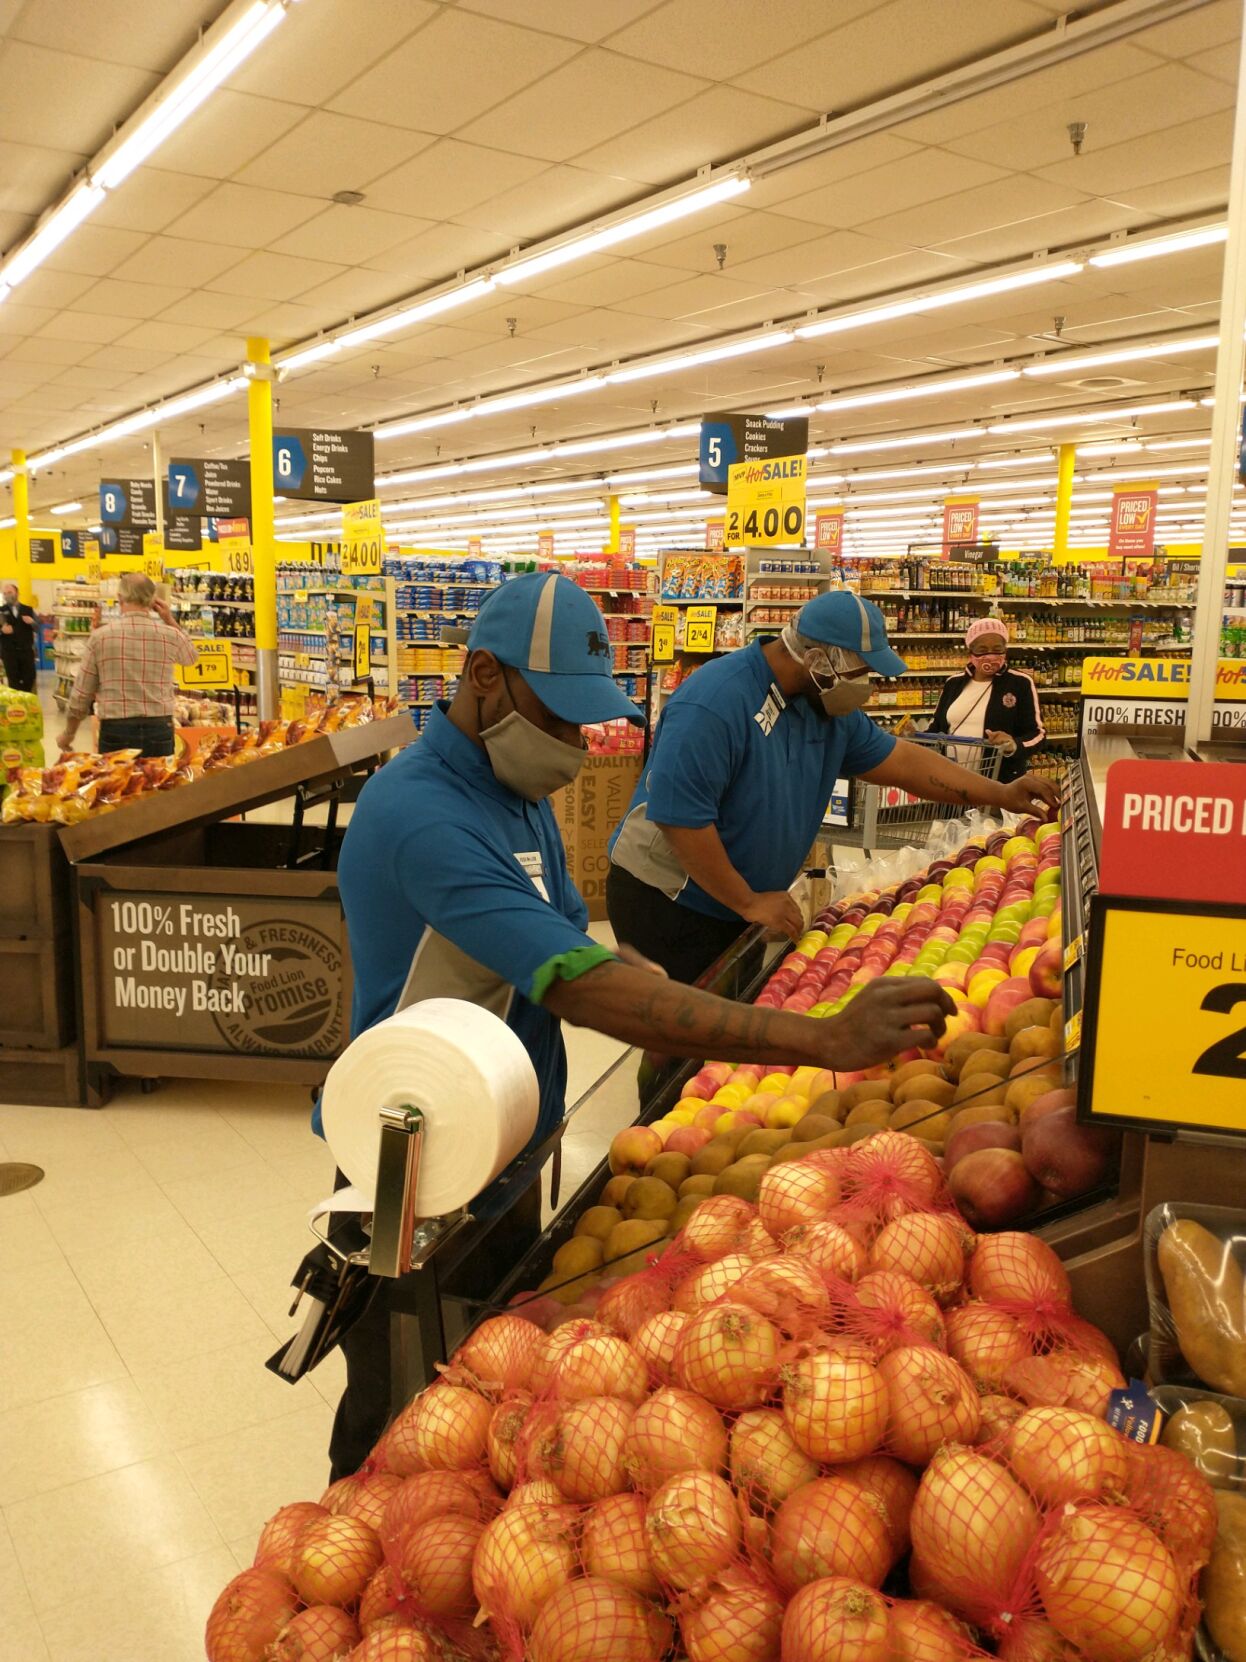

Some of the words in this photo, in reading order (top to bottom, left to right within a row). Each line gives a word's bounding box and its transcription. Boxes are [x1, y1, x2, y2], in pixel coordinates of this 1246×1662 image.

[746, 419, 761, 428] Snack
[763, 420, 784, 431] Pudding
[313, 433, 323, 442] Soft
[324, 434, 341, 443] Drinks
[746, 432, 766, 441] Cookies
[313, 443, 330, 453] Energy
[331, 444, 348, 453] Drinks
[709, 438, 721, 467] 5
[745, 444, 768, 453] Crackers
[278, 448, 291, 476] 6
[313, 454, 328, 463] Chips
[313, 465, 335, 474] Popcorn
[745, 466, 764, 484] Hot
[763, 459, 802, 480] SALE!
[175, 475, 186, 497] 7
[314, 486, 327, 494] Nuts
[326, 476, 342, 485] Cakes
[105, 493, 116, 513] 8
[1120, 501, 1147, 513] PRICED
[729, 512, 739, 531] 2
[745, 506, 803, 538] 4.00
[951, 512, 972, 523] PRICED
[1119, 513, 1136, 525] LOW
[950, 523, 963, 533] LOW
[965, 550, 984, 560] Vinegar
[1088, 662, 1124, 681] Hot
[1121, 663, 1191, 682] SALE!
[1088, 706, 1128, 723] 100%
[1134, 708, 1186, 725] FRESH
[1212, 711, 1246, 728] 00%
[582, 755, 641, 770] QUALITY
[581, 775, 596, 831] EASY
[606, 775, 621, 829] VALUE
[1122, 793, 1234, 835] PRICED
[111, 901, 174, 935] 100%
[180, 904, 241, 938] Fresh
[113, 947, 136, 971] or
[141, 940, 216, 975] Double
[220, 943, 272, 977] Your
[244, 935, 257, 950] &
[258, 927, 342, 972] FRESHNESS
[1172, 947, 1224, 970] Food
[250, 975, 279, 995] Food
[279, 969, 305, 985] Lion
[115, 976, 187, 1017] Money
[192, 980, 246, 1014] Back
[242, 976, 330, 1020] Promise
[1192, 982, 1246, 1079] 2
[1135, 1419, 1149, 1444] FOOD
